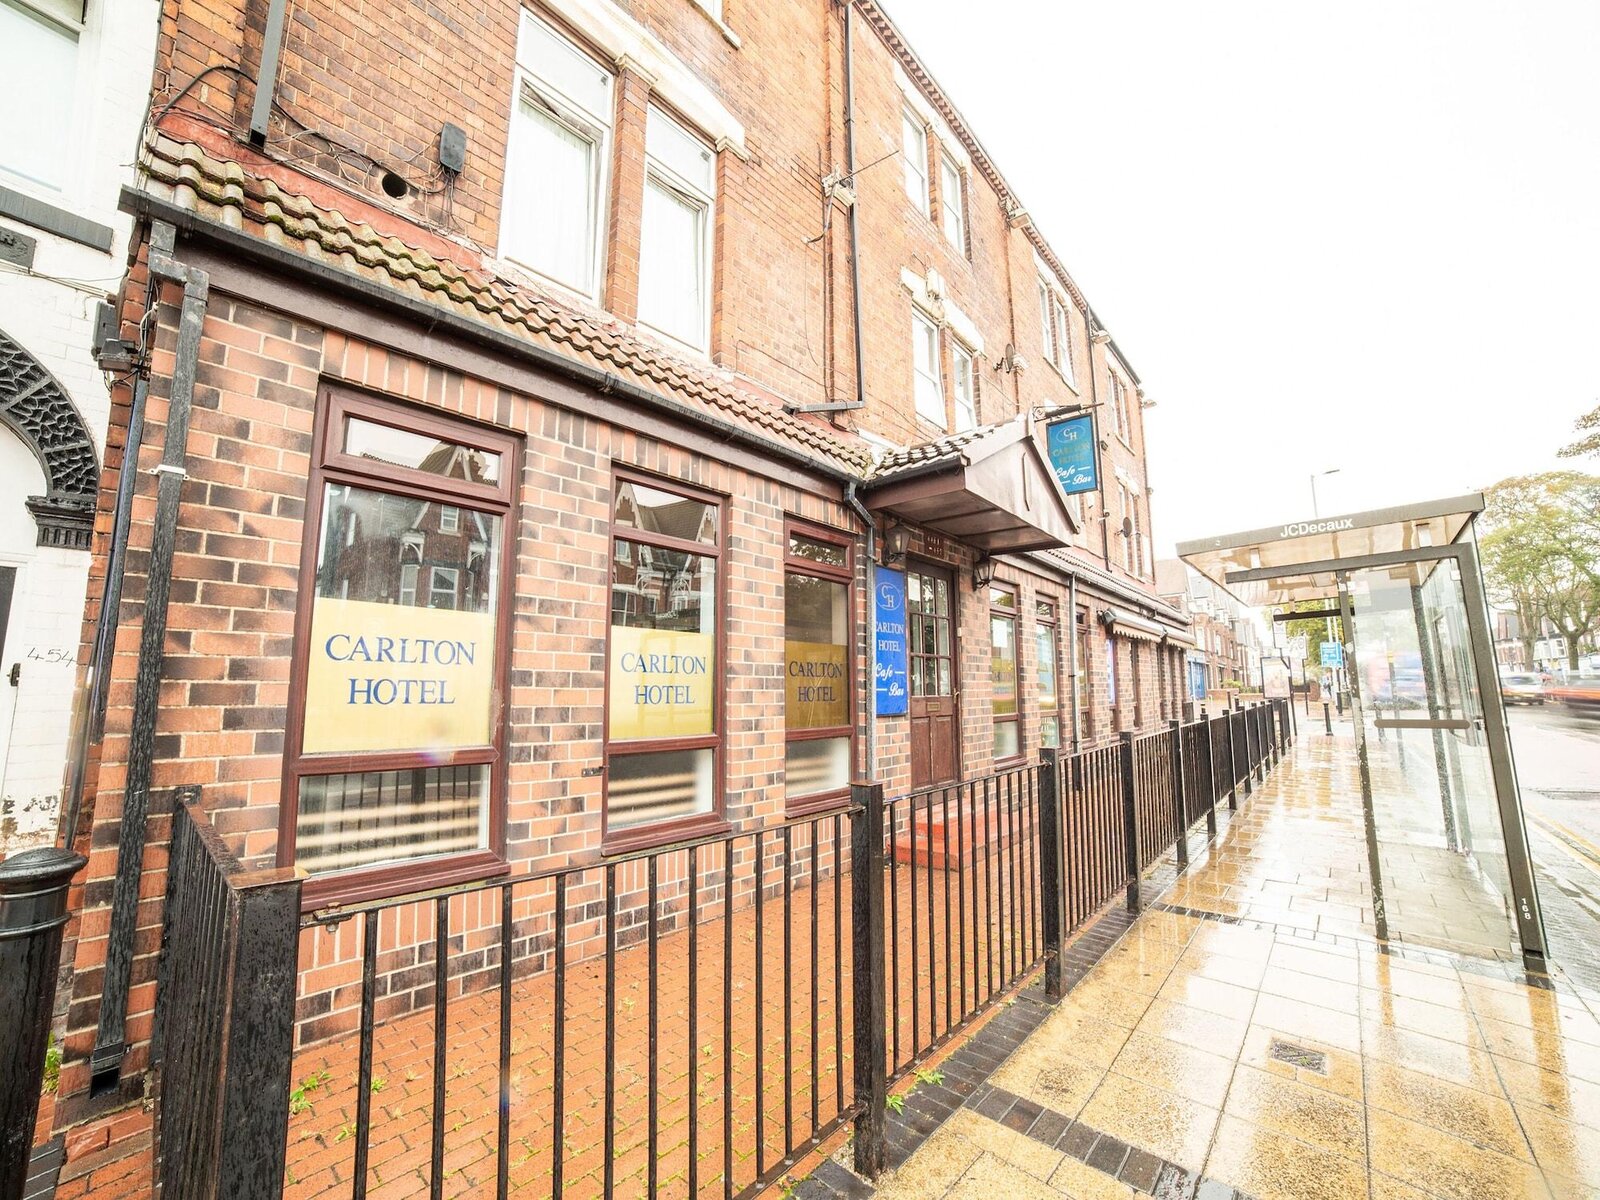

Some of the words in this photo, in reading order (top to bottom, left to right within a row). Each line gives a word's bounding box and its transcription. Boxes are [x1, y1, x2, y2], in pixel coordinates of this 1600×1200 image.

[1056, 465, 1075, 478] Cafe
[1073, 474, 1092, 485] Bar
[1280, 518, 1354, 538] JCDecaux
[325, 634, 476, 665] CARLTON
[878, 640, 901, 651] HOTEL
[28, 647, 77, 668] 454
[621, 652, 706, 675] CARLTON
[789, 660, 842, 679] CARLTON
[347, 678, 455, 705] HOTEL
[634, 685, 695, 705] HOTEL
[797, 686, 836, 702] HOTEL
[888, 681, 904, 696] Bar
[1522, 898, 1531, 919] 168
